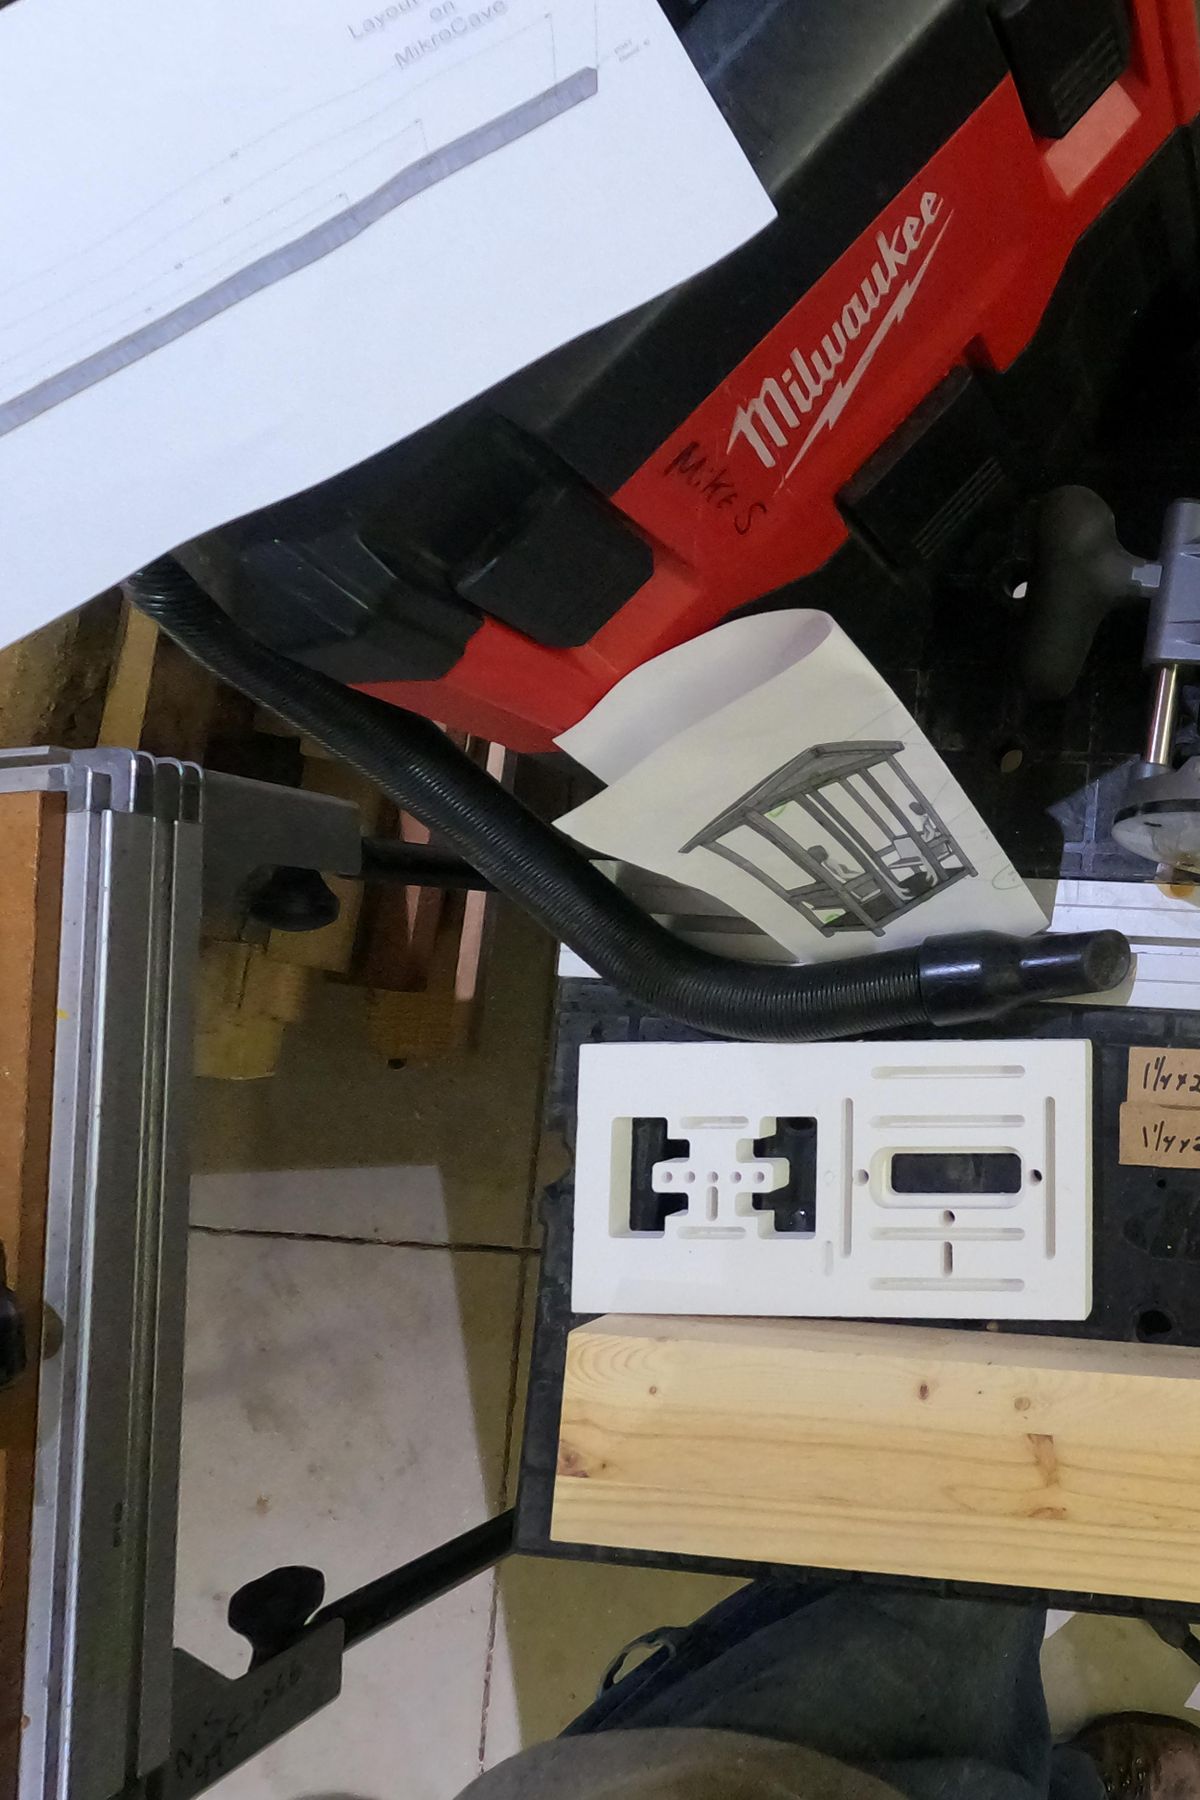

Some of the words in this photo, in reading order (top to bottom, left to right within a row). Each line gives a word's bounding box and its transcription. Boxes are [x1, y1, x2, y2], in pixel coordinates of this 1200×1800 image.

[347, 0, 421, 40] Layou
[429, 0, 456, 21] on
[726, 191, 943, 469] Milwaukee
